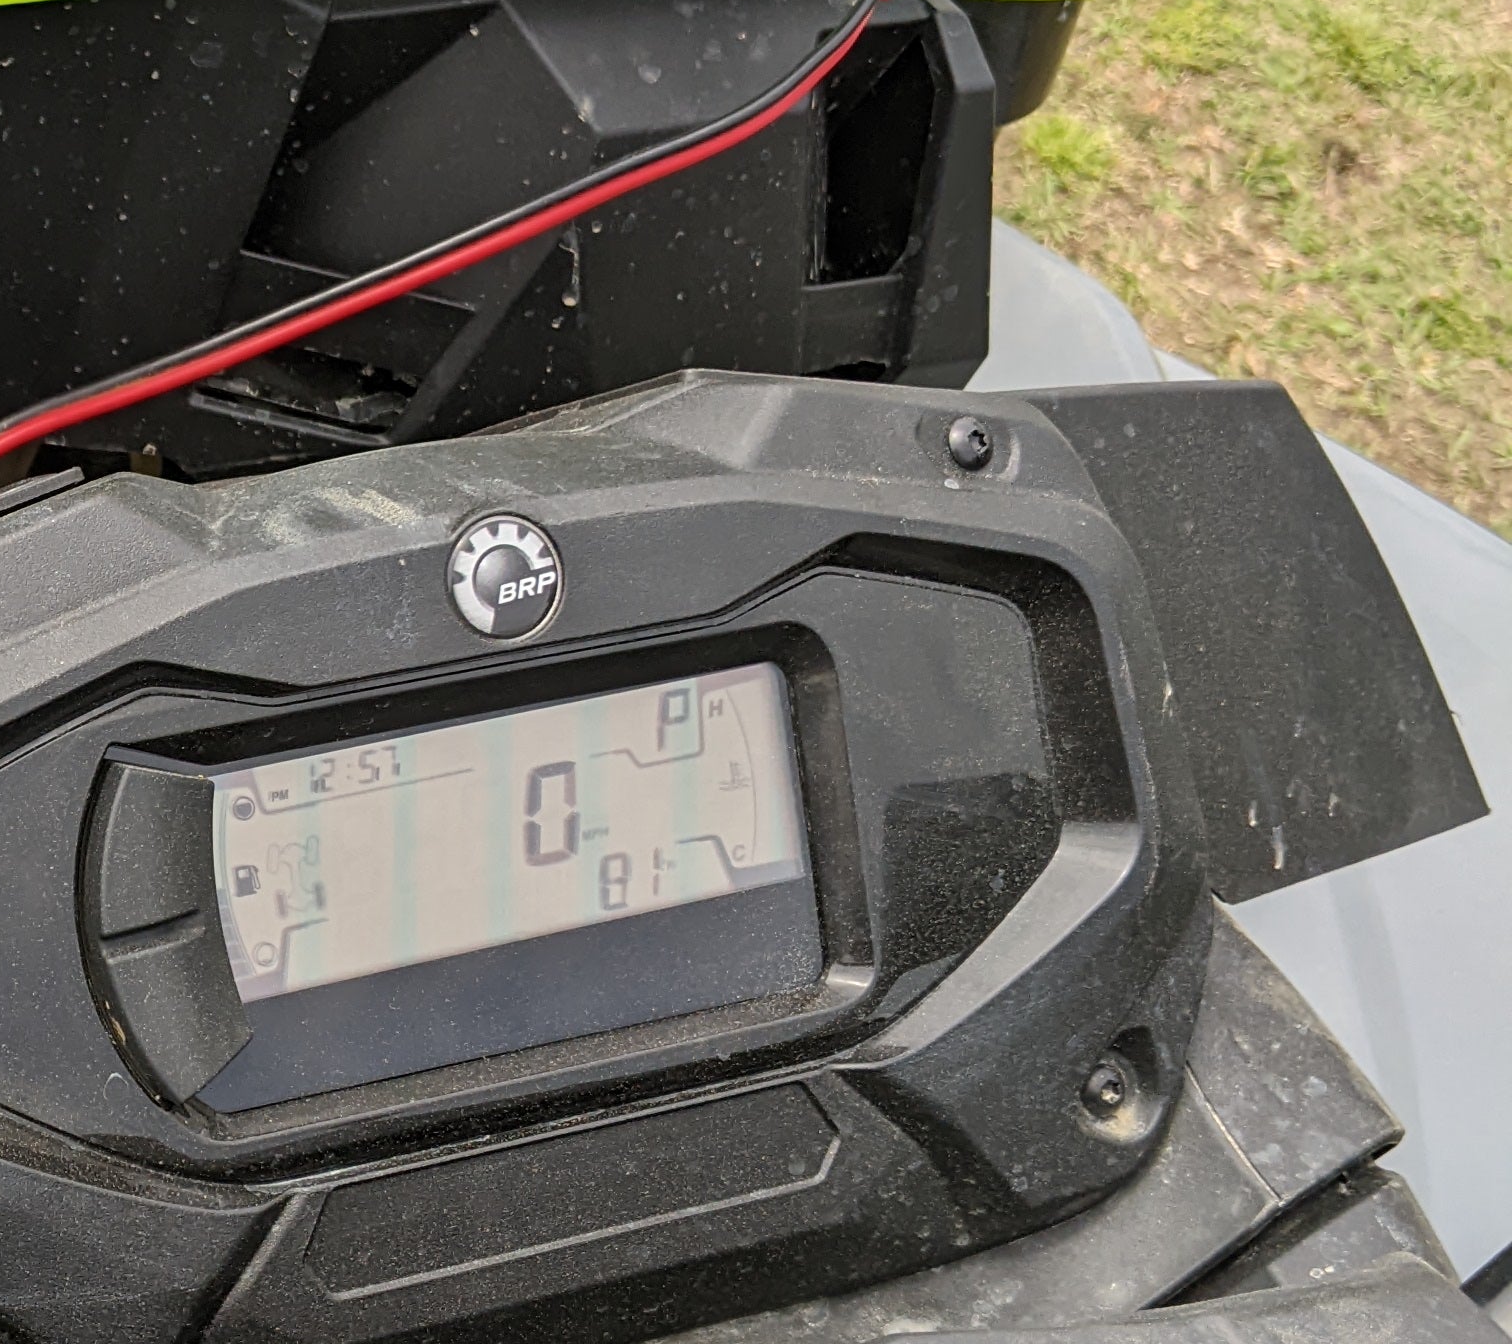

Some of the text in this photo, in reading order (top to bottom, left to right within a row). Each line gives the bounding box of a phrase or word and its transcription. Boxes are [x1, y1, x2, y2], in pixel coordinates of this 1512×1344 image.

[498, 571, 556, 605] BRP
[656, 687, 691, 753] P
[523, 760, 581, 868] 0
